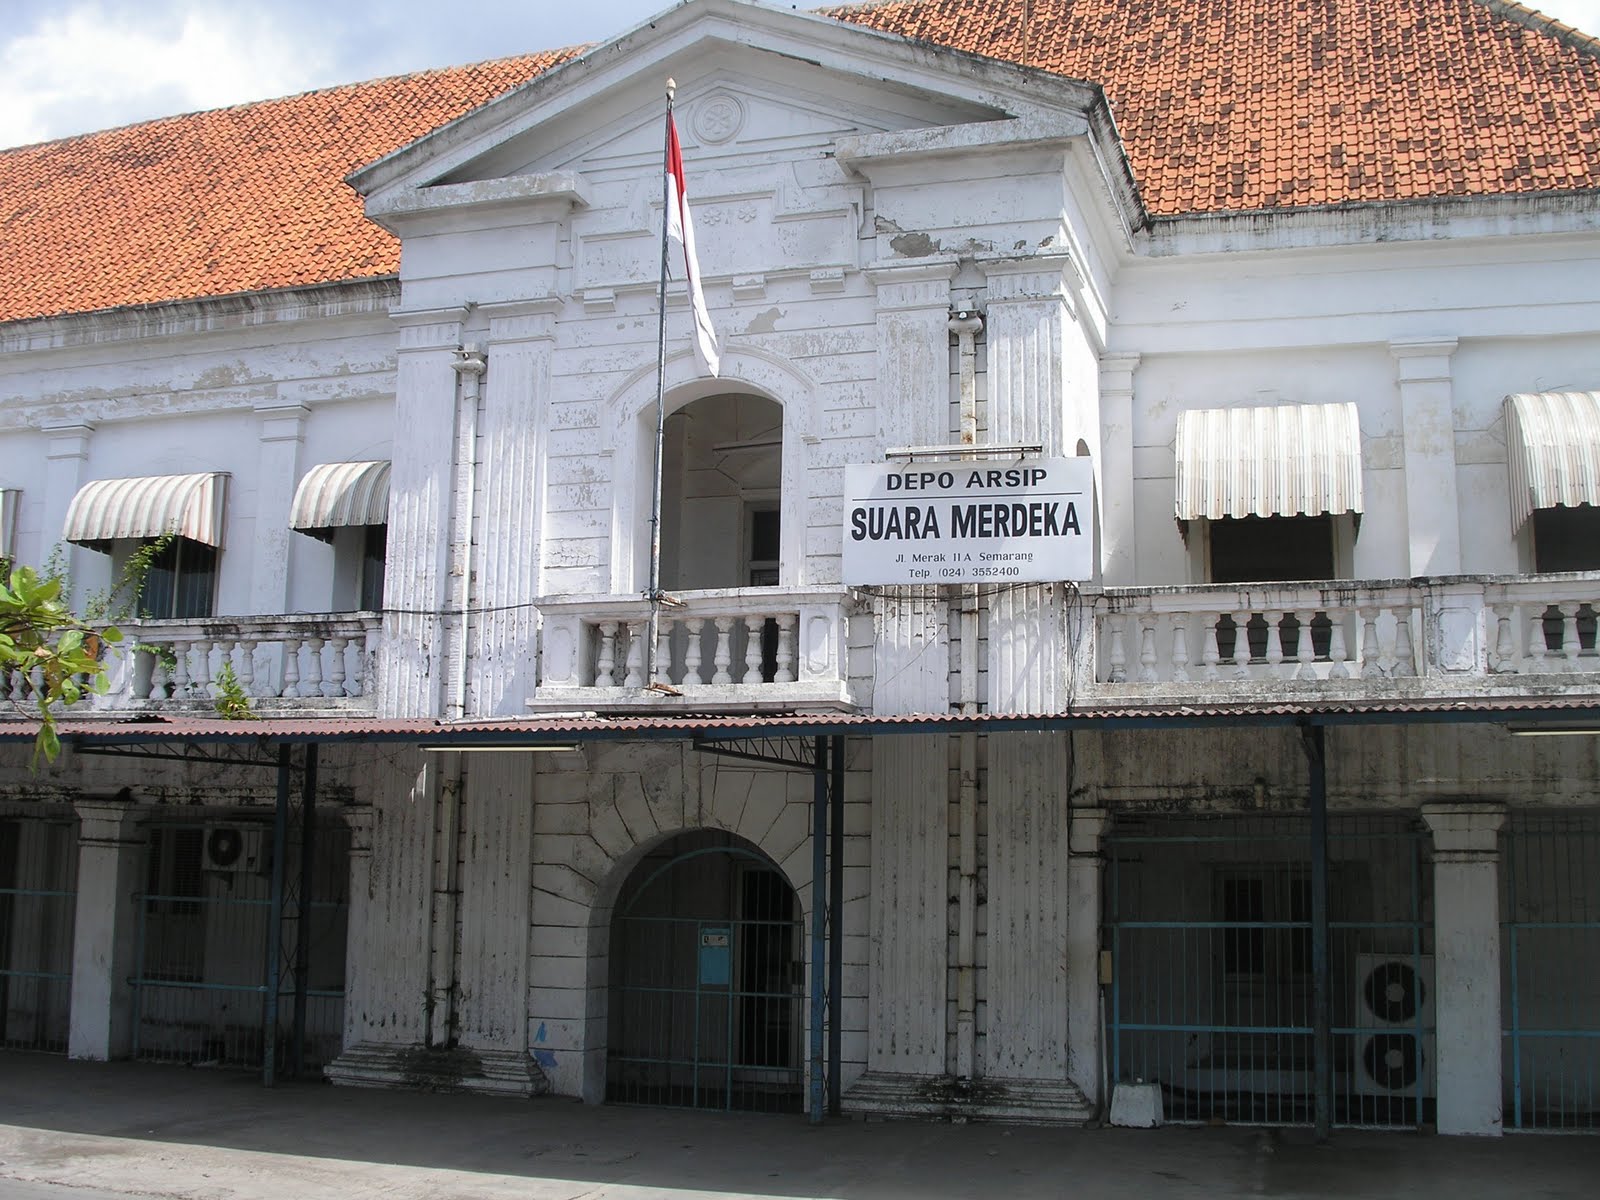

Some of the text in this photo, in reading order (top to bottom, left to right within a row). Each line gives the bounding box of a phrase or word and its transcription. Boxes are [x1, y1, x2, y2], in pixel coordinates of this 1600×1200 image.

[886, 468, 1047, 491] DEPO ARSIP
[851, 502, 1081, 541] SUARA MERDEKA
[895, 553, 906, 562] Jl.
[912, 553, 946, 562] Merak
[979, 552, 1033, 562] Semarang
[909, 566, 1019, 579] Telp. (024) 3552400
